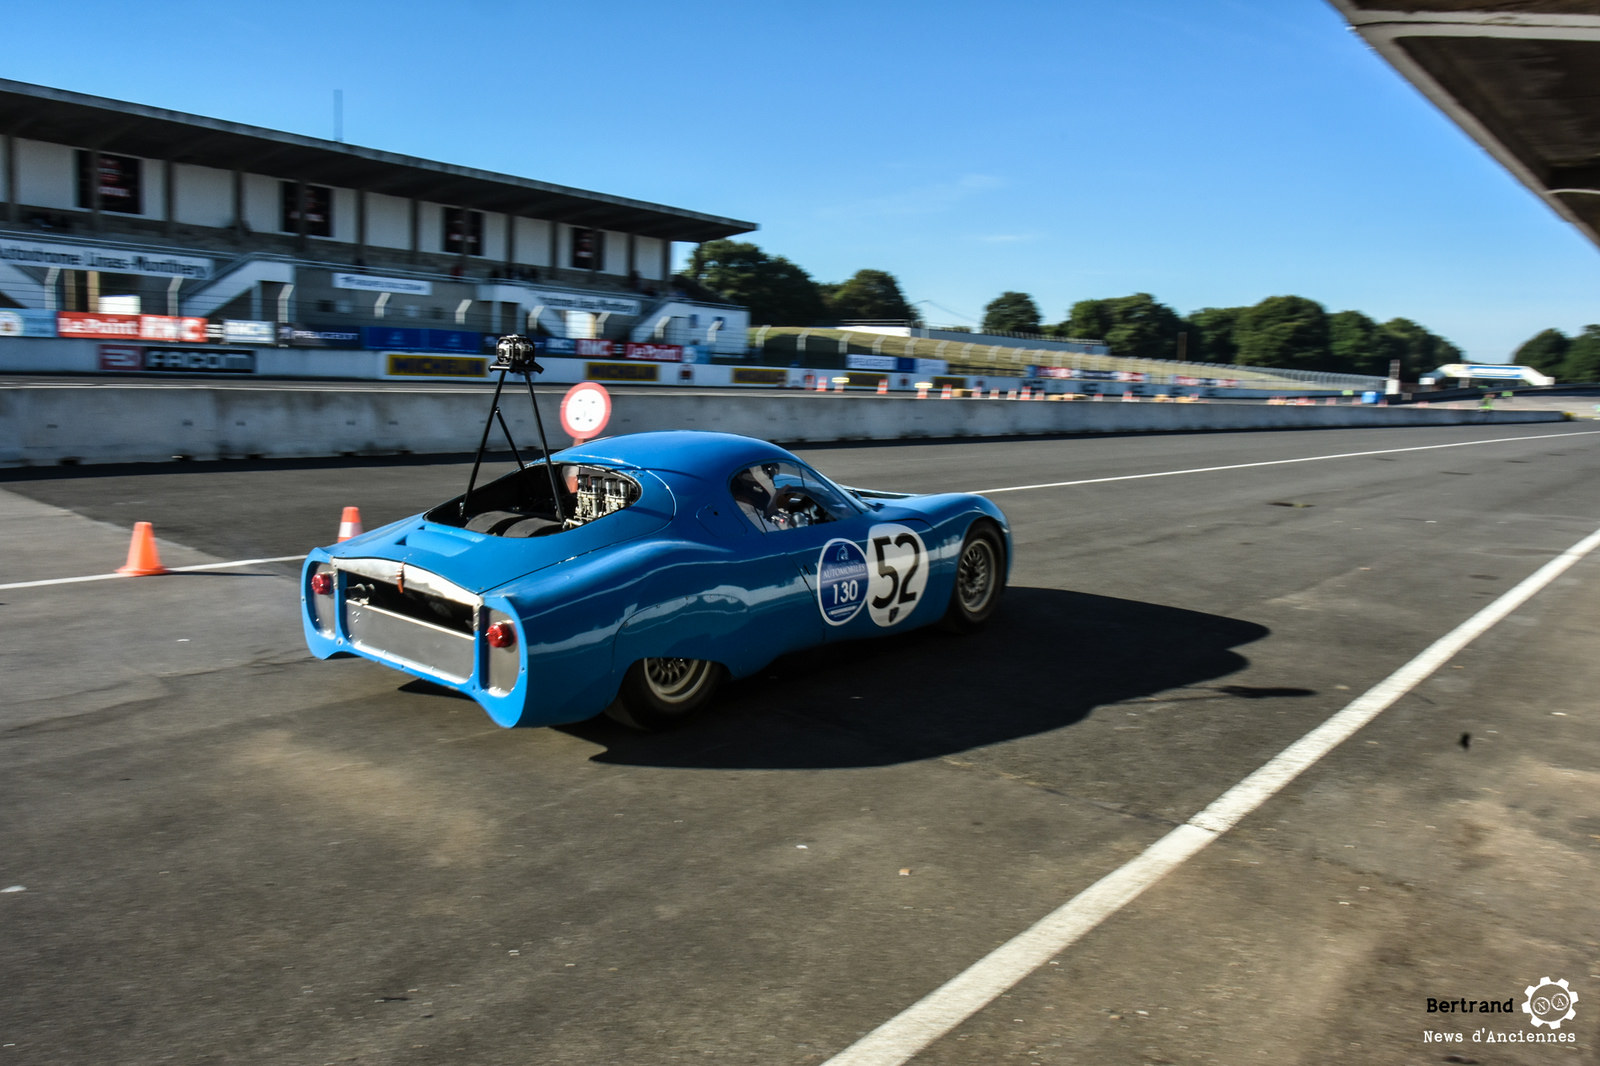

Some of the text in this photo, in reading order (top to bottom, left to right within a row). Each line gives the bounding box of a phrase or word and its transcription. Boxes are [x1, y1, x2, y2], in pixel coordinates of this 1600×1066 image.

[149, 351, 254, 370] FACOM
[872, 532, 920, 610] 52
[833, 580, 858, 605] 130
